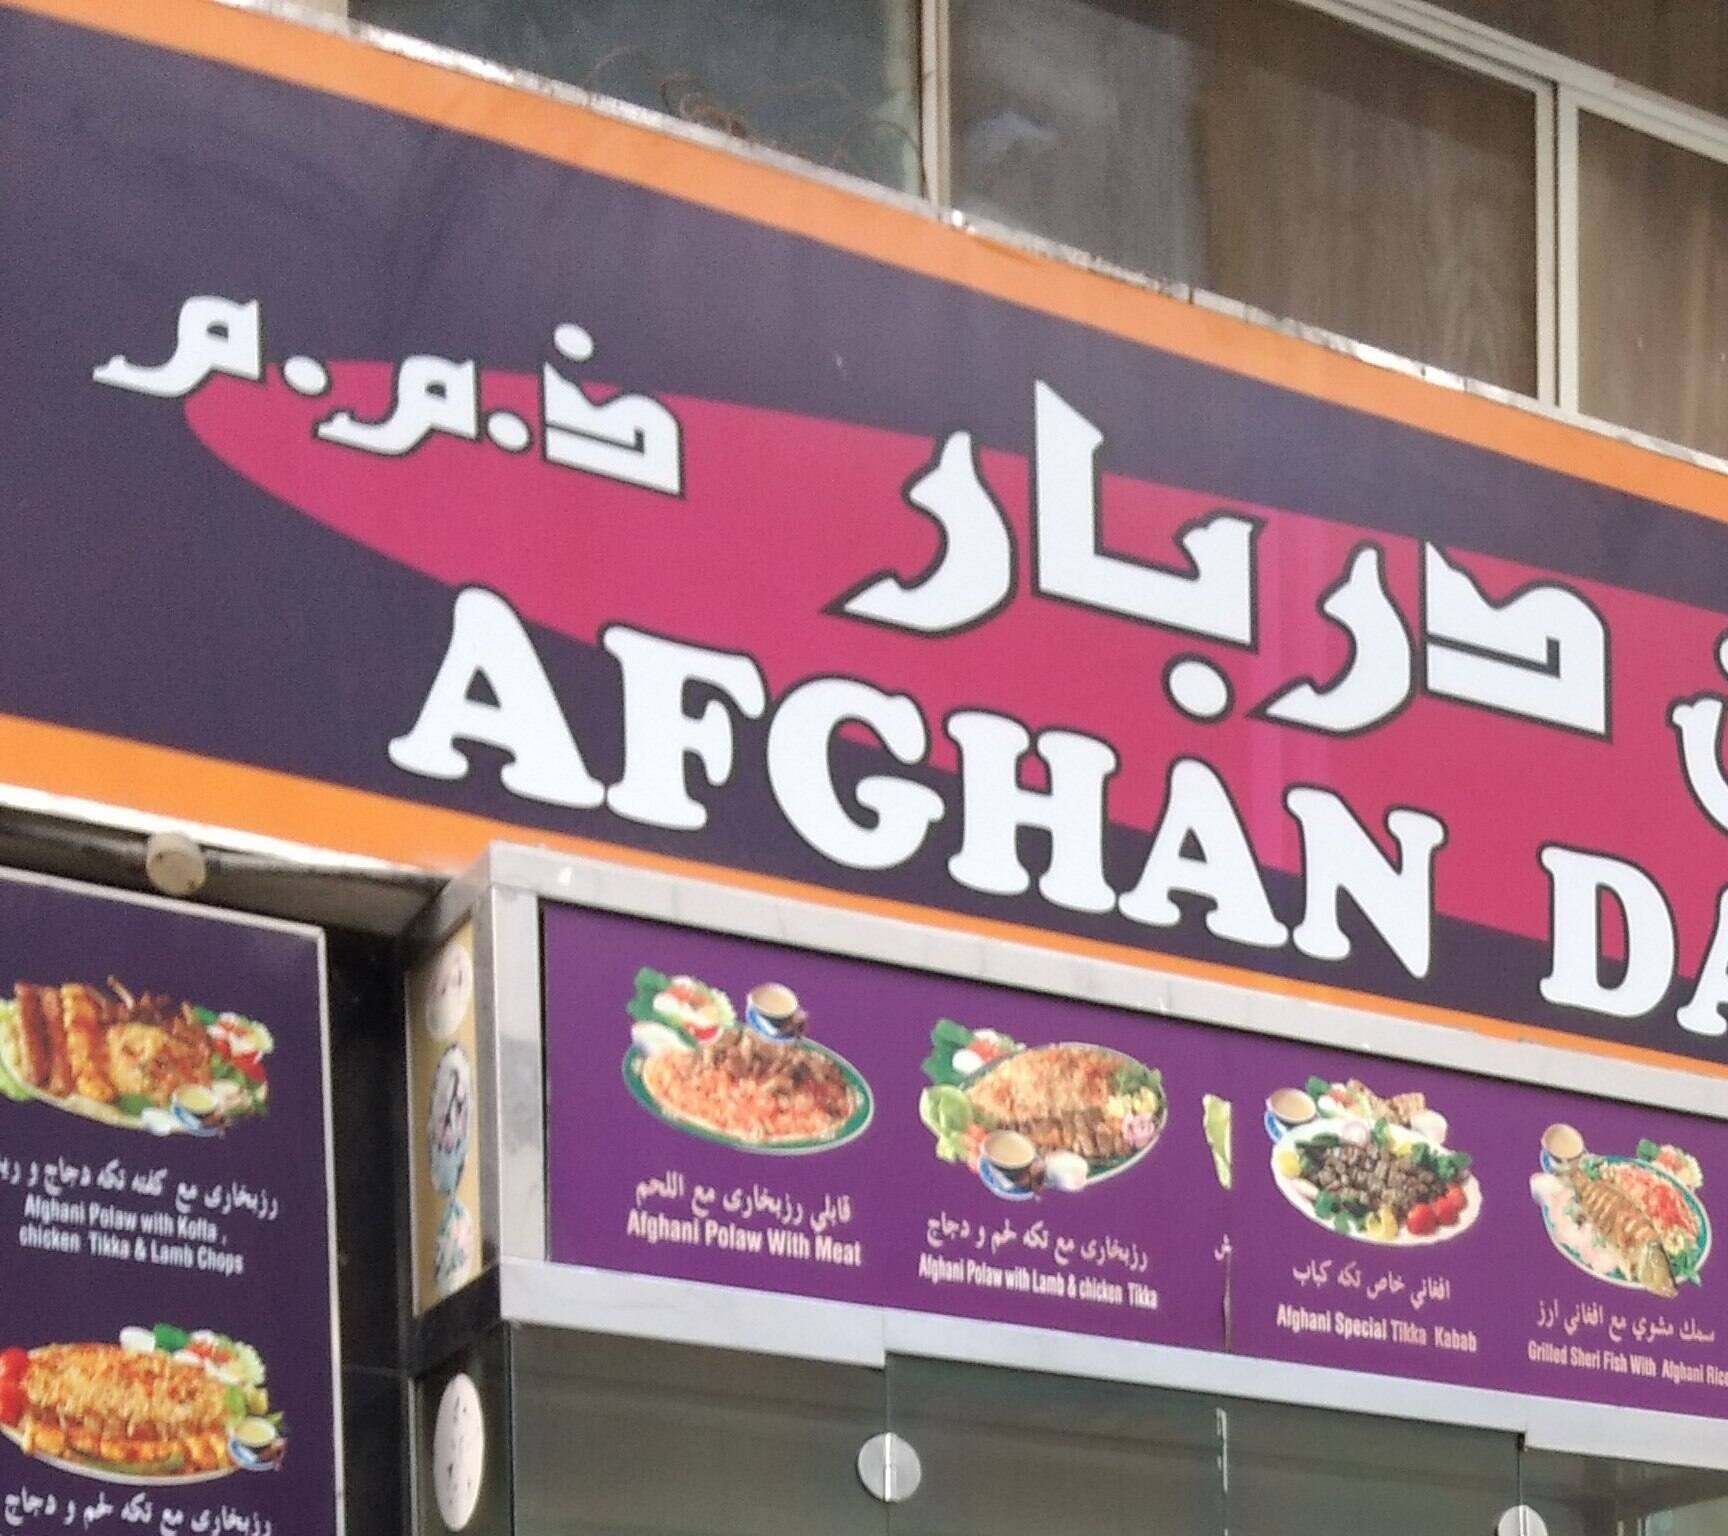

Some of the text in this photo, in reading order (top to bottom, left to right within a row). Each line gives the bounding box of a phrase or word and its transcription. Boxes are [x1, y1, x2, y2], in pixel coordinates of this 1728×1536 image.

[840, 380, 1609, 736] دربار
[388, 587, 1448, 979] AFGHAN
[24, 1193, 86, 1225] Afghani
[89, 1201, 138, 1232] Polaw
[140, 1211, 174, 1238] with
[691, 1184, 716, 1219] مع
[19, 1223, 244, 1278] chicken Tikka & Lamb Chops
[627, 1207, 862, 1268] Afghani Polaw With Meat
[918, 1252, 1159, 1311] Afghani Polaw with Lamb & chicken Tikka
[1276, 1303, 1478, 1353] Afghani Special Tikka Kabab
[1608, 1313, 1627, 1343] مع
[1679, 1317, 1716, 1343] سمك
[1528, 1340, 1568, 1366] Grilled
[1603, 1350, 1628, 1375] Fish
[1630, 1354, 1657, 1378] With
[1661, 1358, 1704, 1385] Afghani
